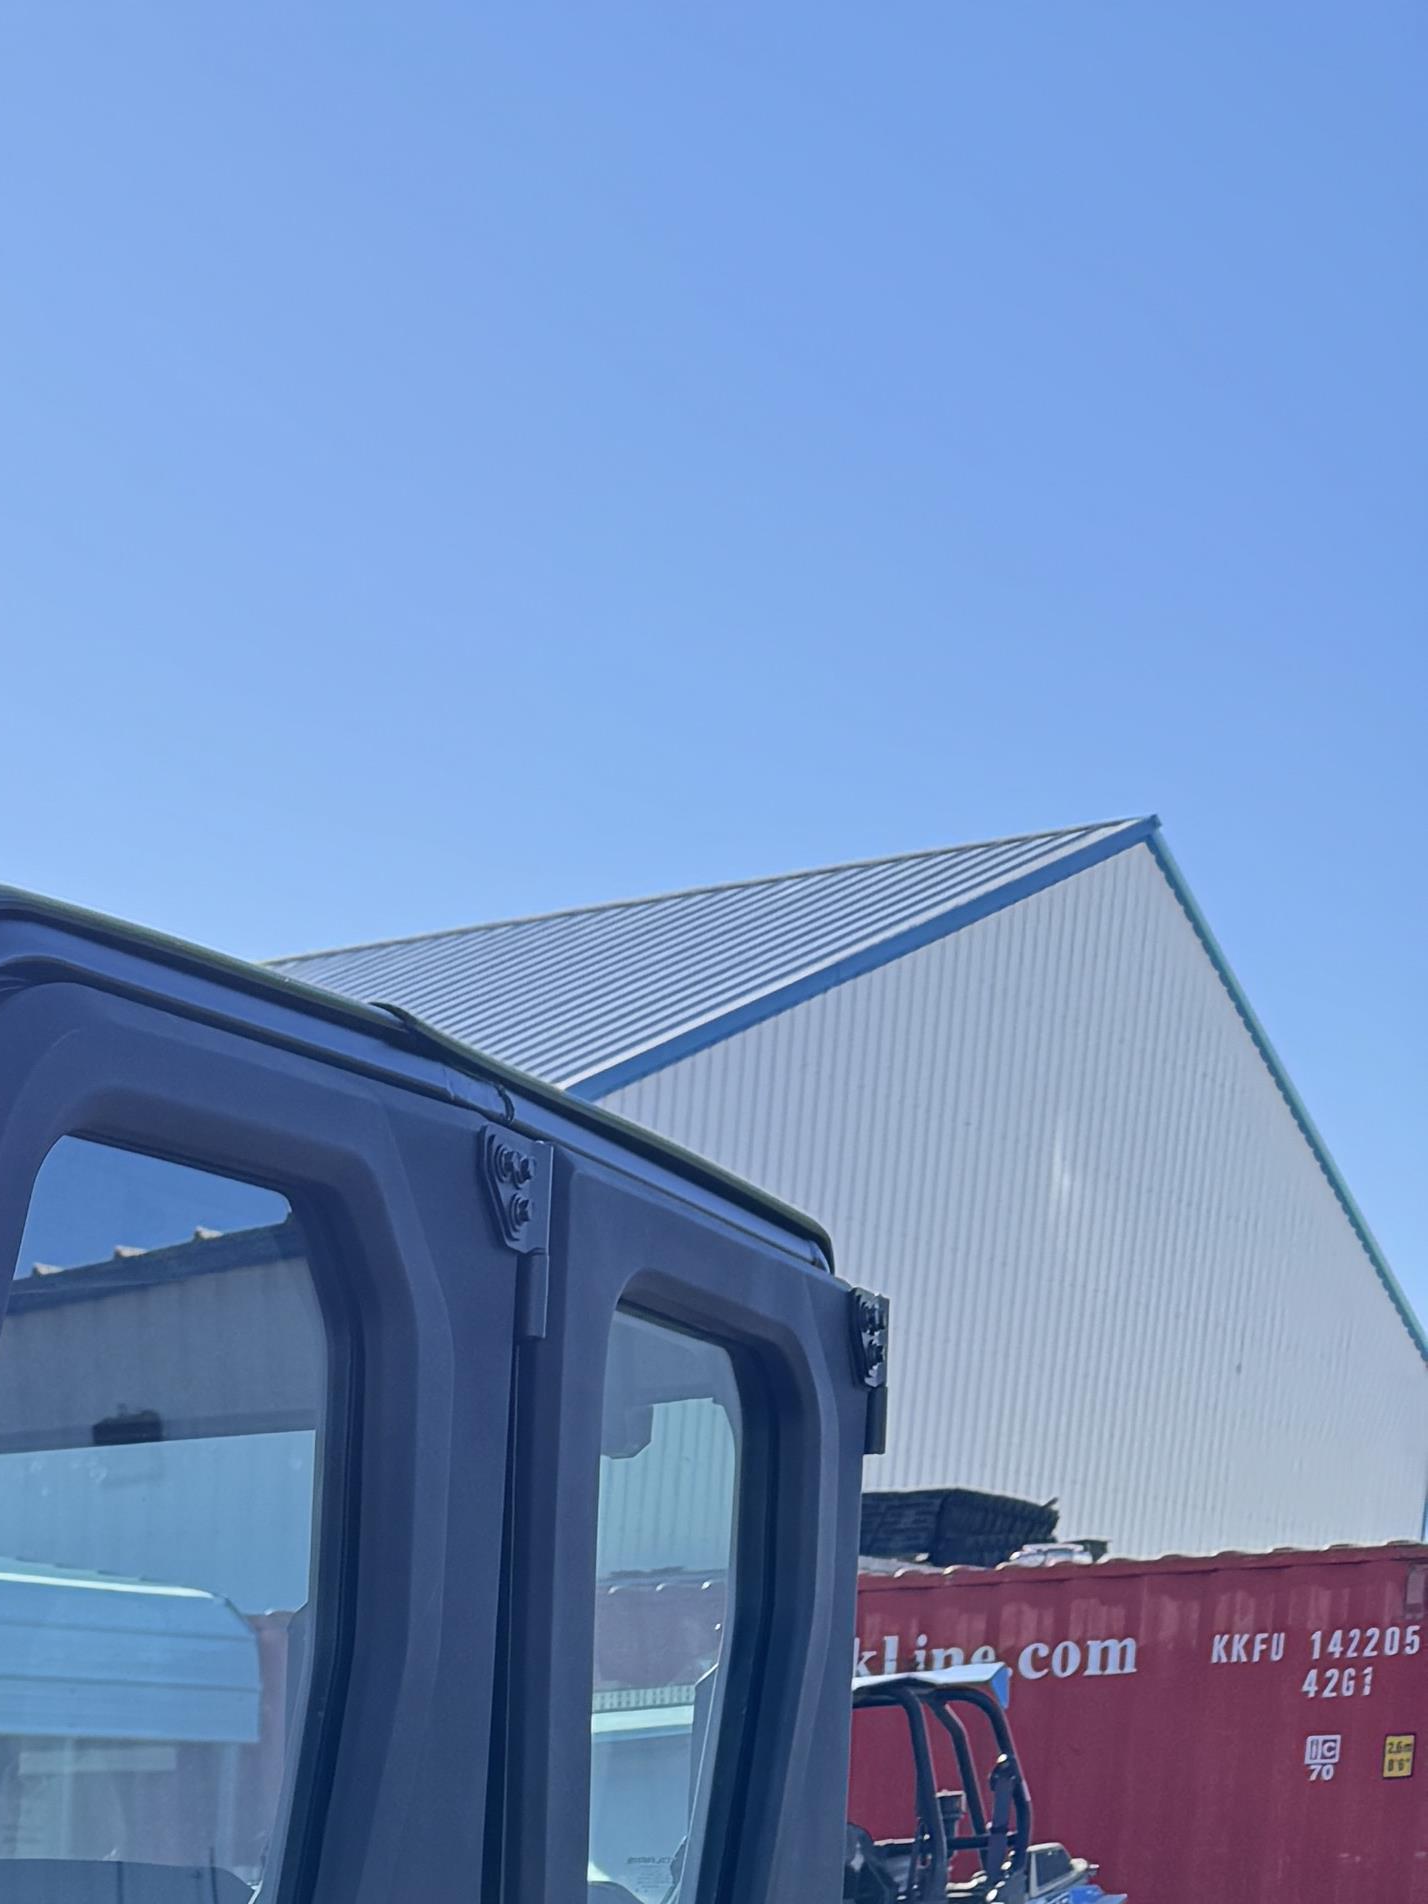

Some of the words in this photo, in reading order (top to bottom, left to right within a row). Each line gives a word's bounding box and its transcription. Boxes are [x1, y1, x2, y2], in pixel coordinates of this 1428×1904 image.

[1210, 1632, 1286, 1664] KKFU
[1310, 1625, 1422, 1661] 142205
[1301, 1666, 1374, 1699] 42G1
[1308, 1764, 1335, 1781] 70
